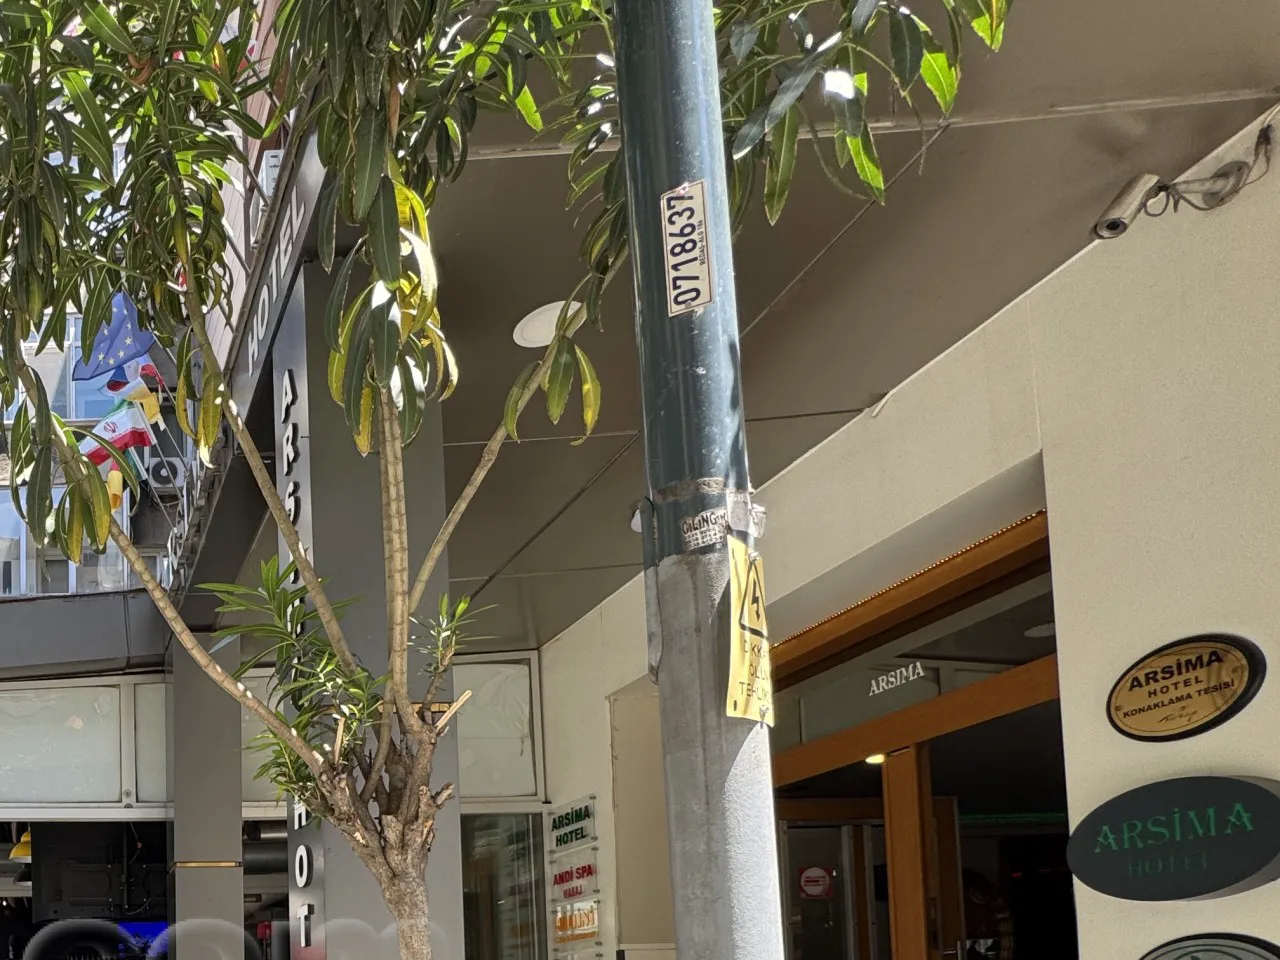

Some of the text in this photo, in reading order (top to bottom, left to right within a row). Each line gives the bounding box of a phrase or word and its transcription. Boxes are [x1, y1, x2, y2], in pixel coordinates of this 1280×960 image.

[667, 195, 701, 305] 0718637
[248, 185, 306, 378] HOTEL
[869, 661, 925, 696] ARSIMA
[1128, 650, 1224, 692] ARSİMA
[1147, 675, 1204, 698] HOTEL
[1122, 678, 1235, 718] KONAKLAMA TESİSİ
[551, 805, 591, 832] ARSİMA
[1094, 802, 1254, 853] ARSİMA
[555, 830, 588, 848] HOTEL
[553, 863, 594, 887] ANDİ SPA
[1128, 851, 1208, 877] HOTEL
